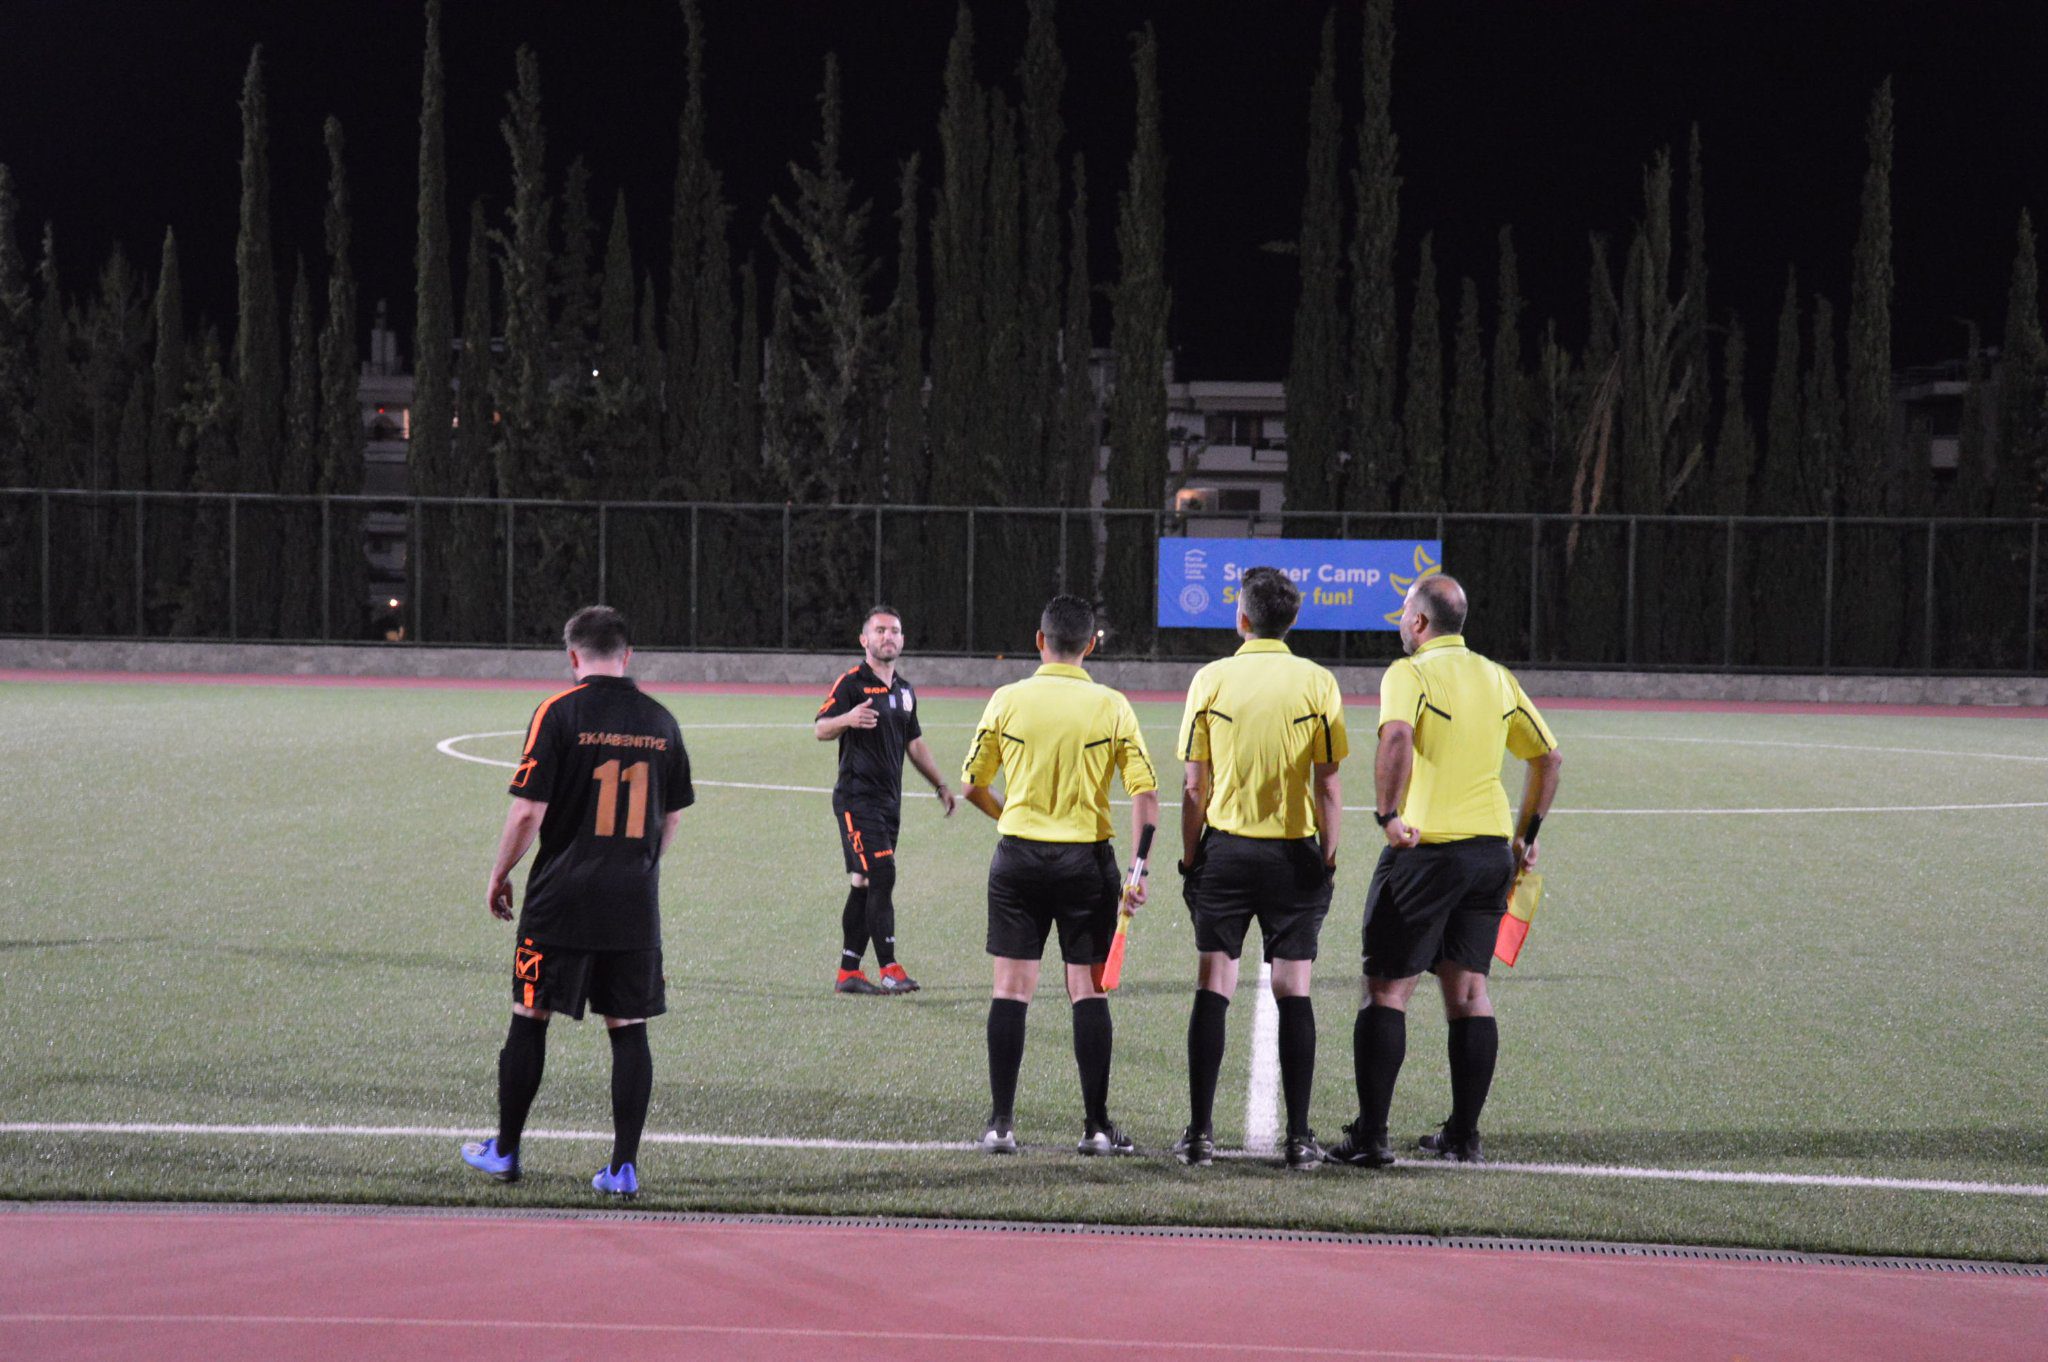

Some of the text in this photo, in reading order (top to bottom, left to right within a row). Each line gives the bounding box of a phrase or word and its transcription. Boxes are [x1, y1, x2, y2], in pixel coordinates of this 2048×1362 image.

[1318, 564, 1381, 587] Camp
[1313, 586, 1354, 605] fun!
[592, 759, 649, 839] 11
